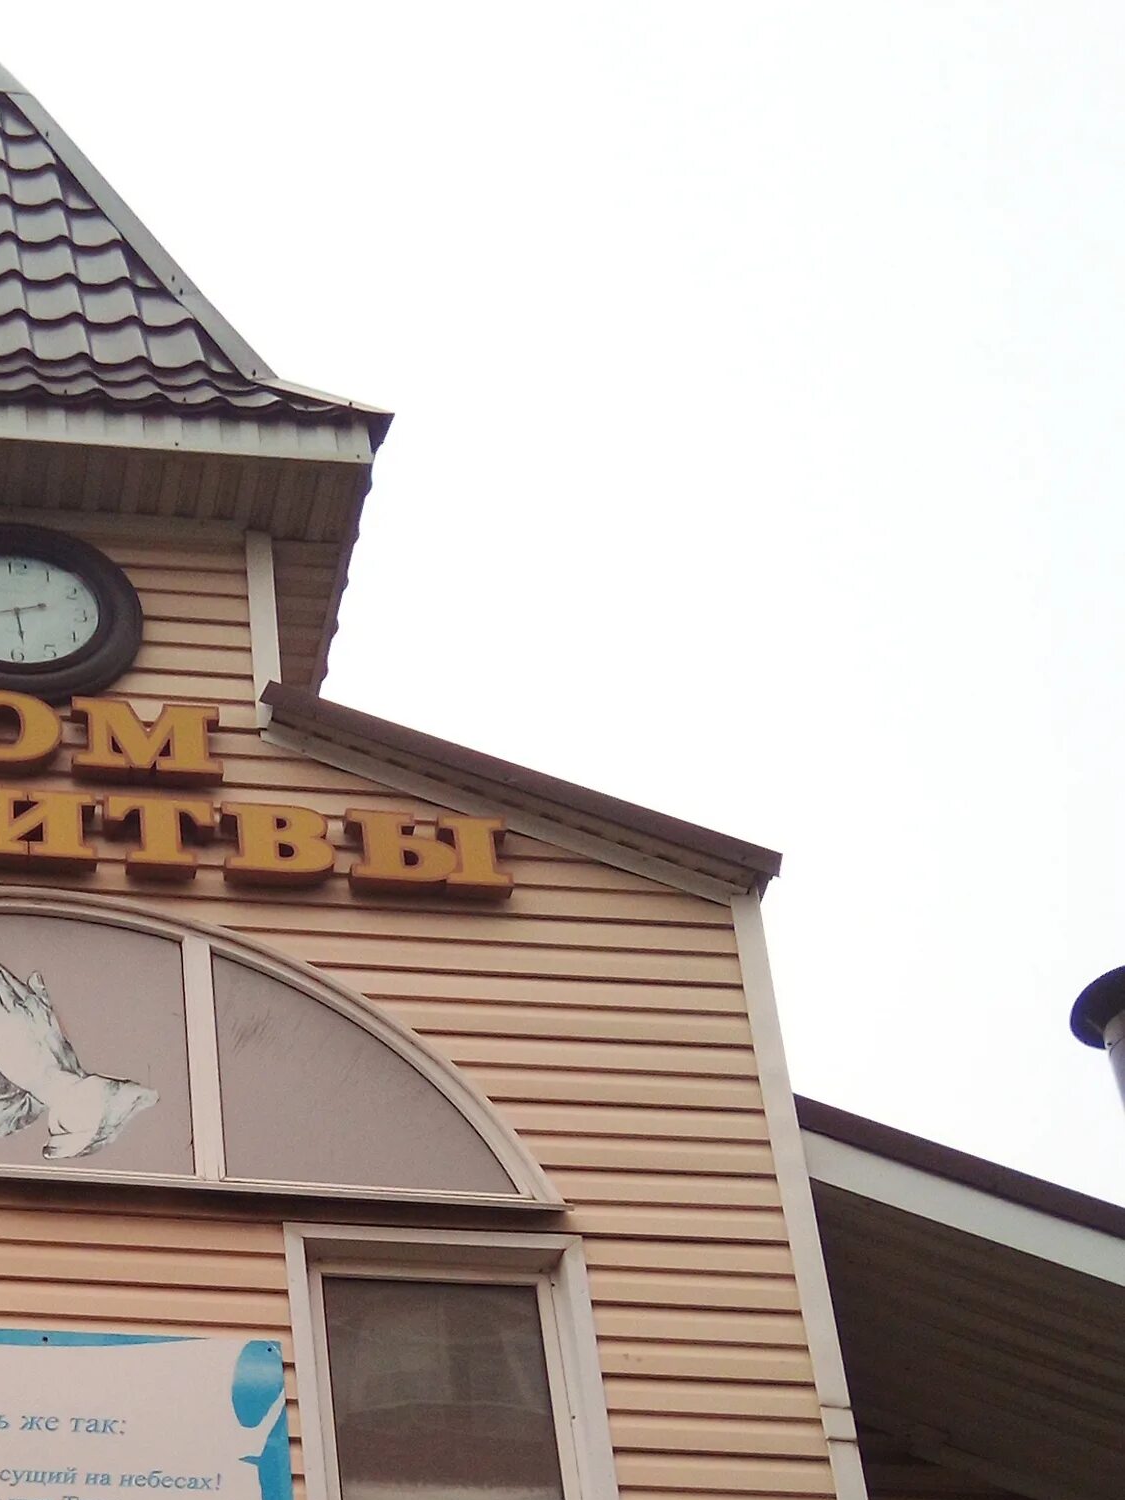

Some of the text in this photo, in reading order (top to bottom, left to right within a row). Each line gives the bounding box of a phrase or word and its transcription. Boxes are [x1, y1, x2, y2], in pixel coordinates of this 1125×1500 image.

[8, 561, 27, 575] 12
[66, 587, 77, 600] 2
[10, 648, 24, 662] 6
[43, 643, 57, 659] 5
[19, 1414, 60, 1433] же
[69, 1417, 127, 1436] так:
[84, 1472, 113, 1487] на
[118, 1469, 222, 1491] небесах!
